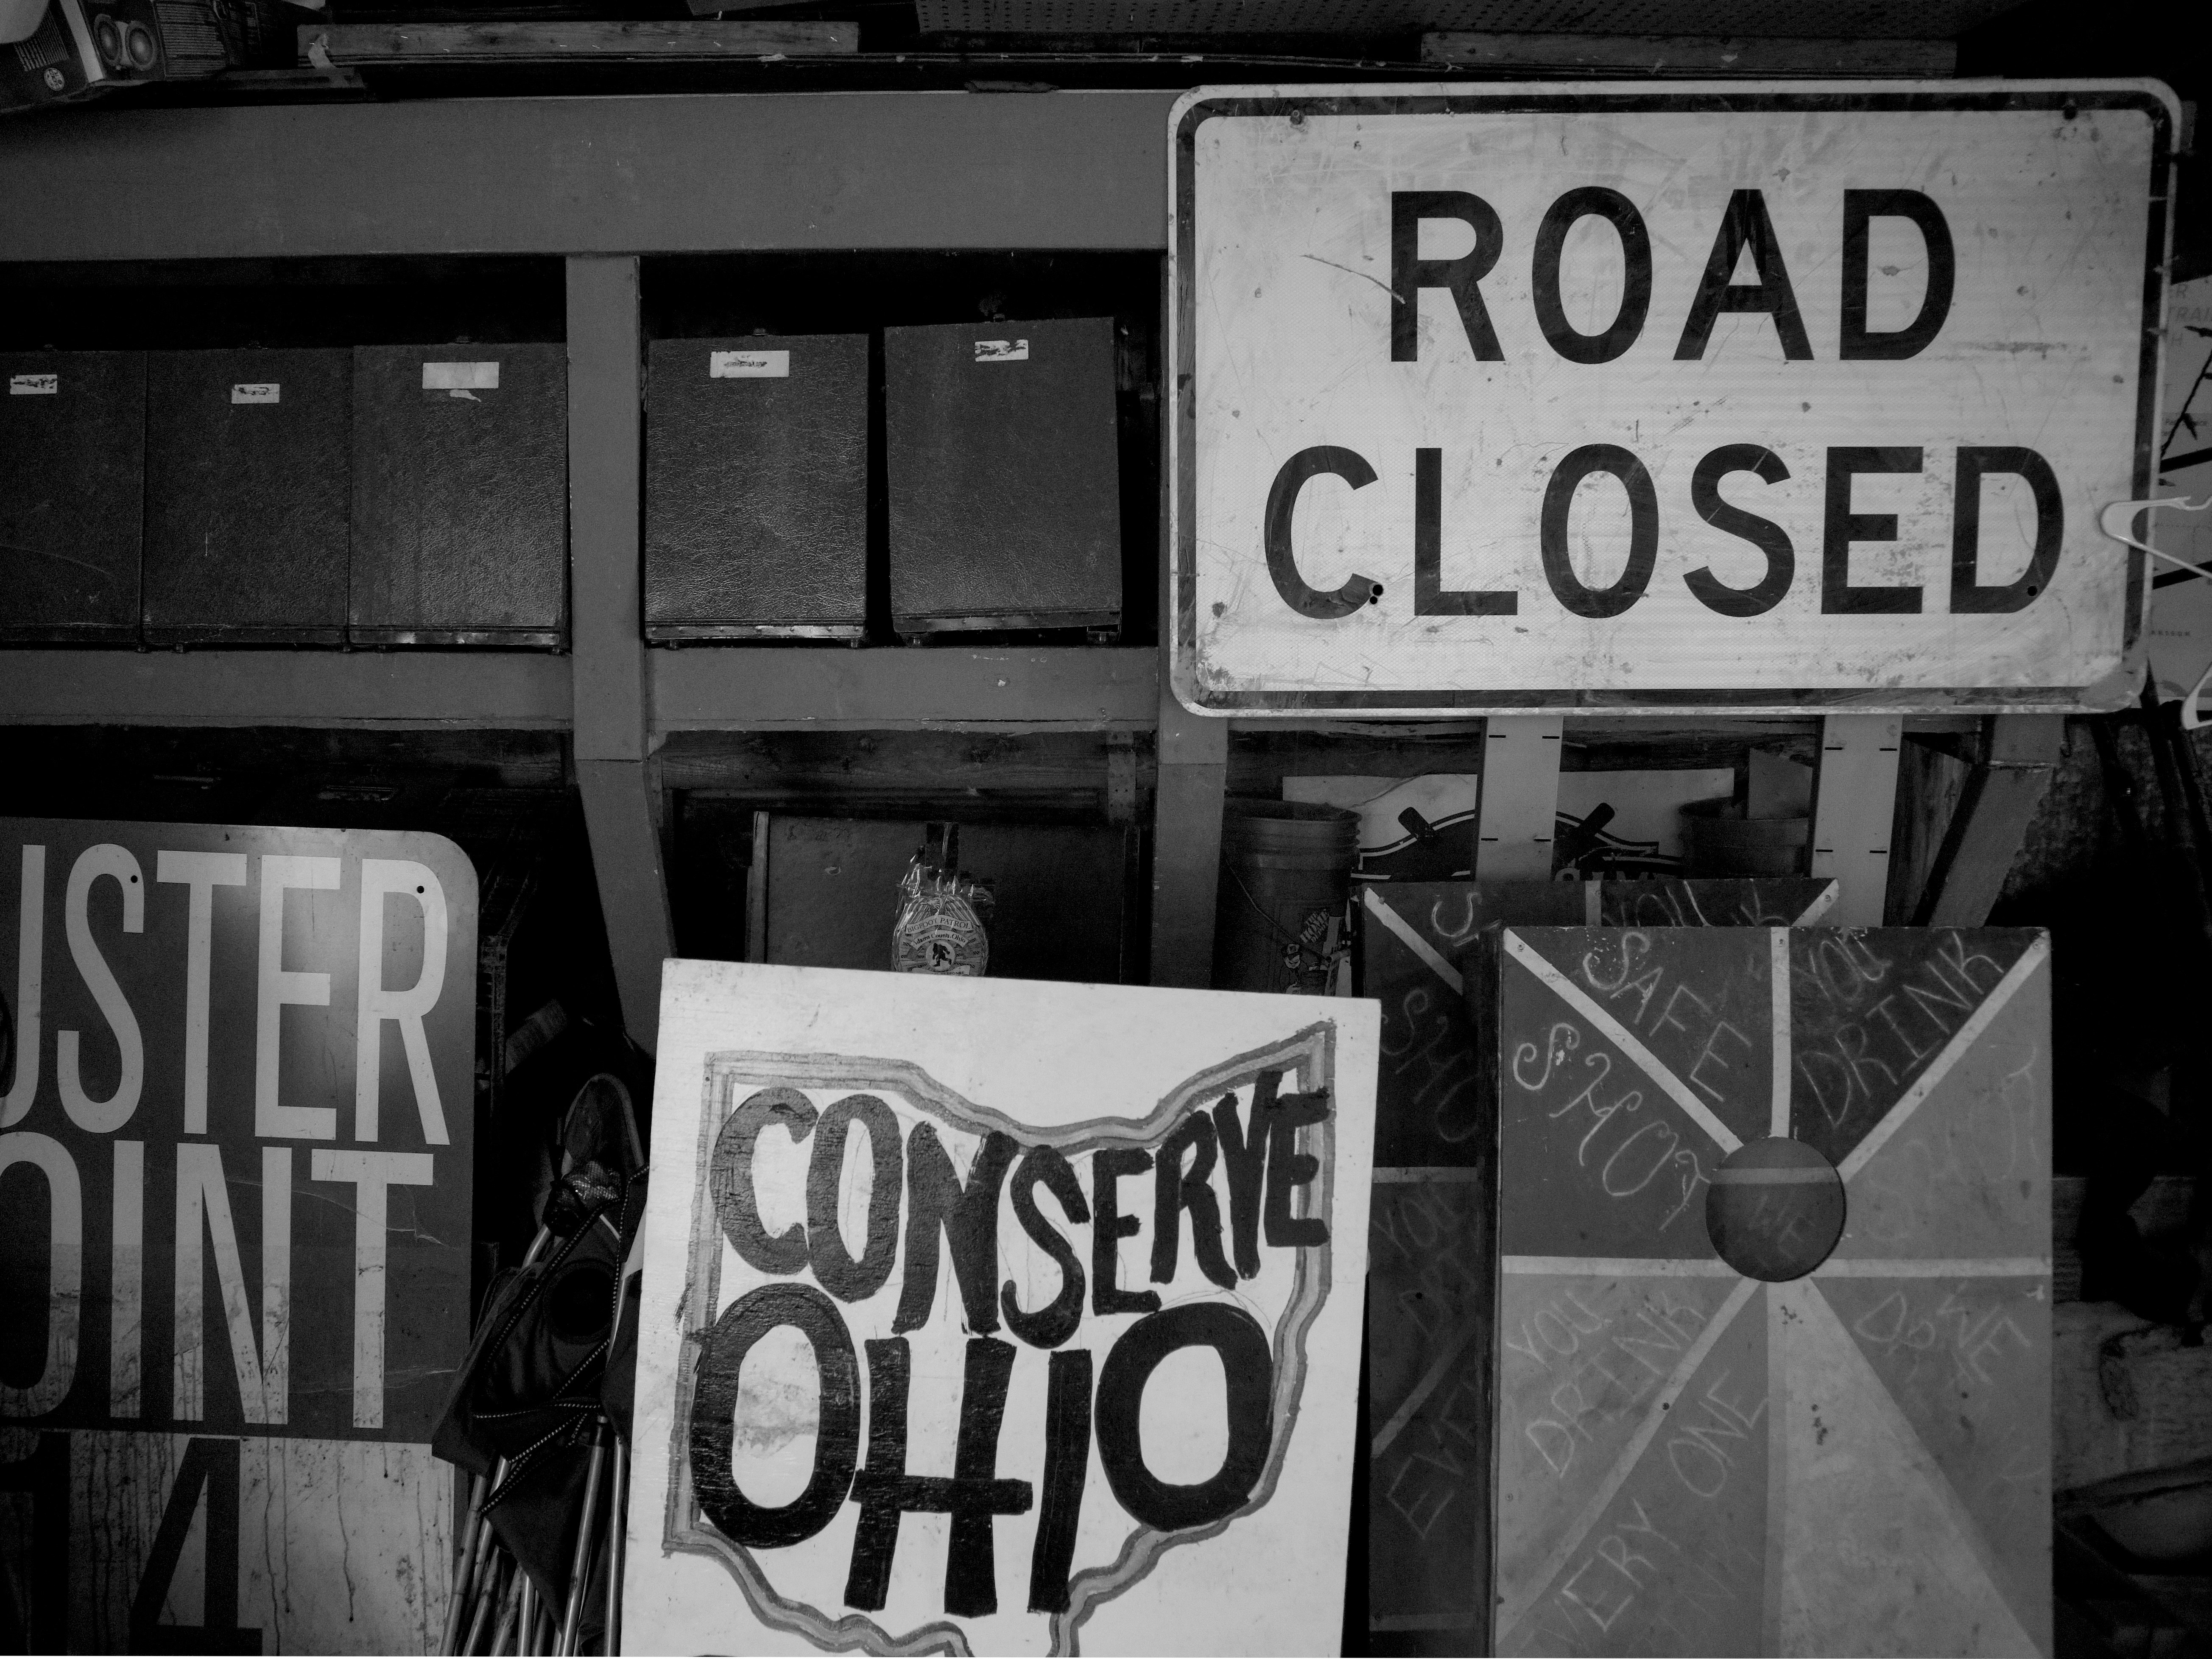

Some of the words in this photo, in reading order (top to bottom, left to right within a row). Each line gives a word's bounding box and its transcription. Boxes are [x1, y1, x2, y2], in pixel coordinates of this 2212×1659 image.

[1391, 186, 1955, 364] ROAD
[1264, 444, 2064, 618] CLOSED
[907, 918, 937, 933] BIGFOOT
[940, 917, 972, 929] PATROL
[913, 936, 930, 945] Adams
[952, 934, 966, 943] Ohio
[1299, 908, 1329, 943] HOME
[1792, 929, 1892, 1011] YOU
[1582, 931, 1752, 1102] SAFE
[1799, 930, 2005, 1128] DRINK
[711, 1072, 1329, 1347] CONSERVE
[1512, 1023, 1711, 1232] SHOT
[1506, 1289, 1612, 1369] YOU
[1525, 1292, 1705, 1478] DRINK
[1936, 1281, 2030, 1385] WE
[690, 1282, 1272, 1616] OHIO
[1667, 1369, 1769, 1498] ONE
